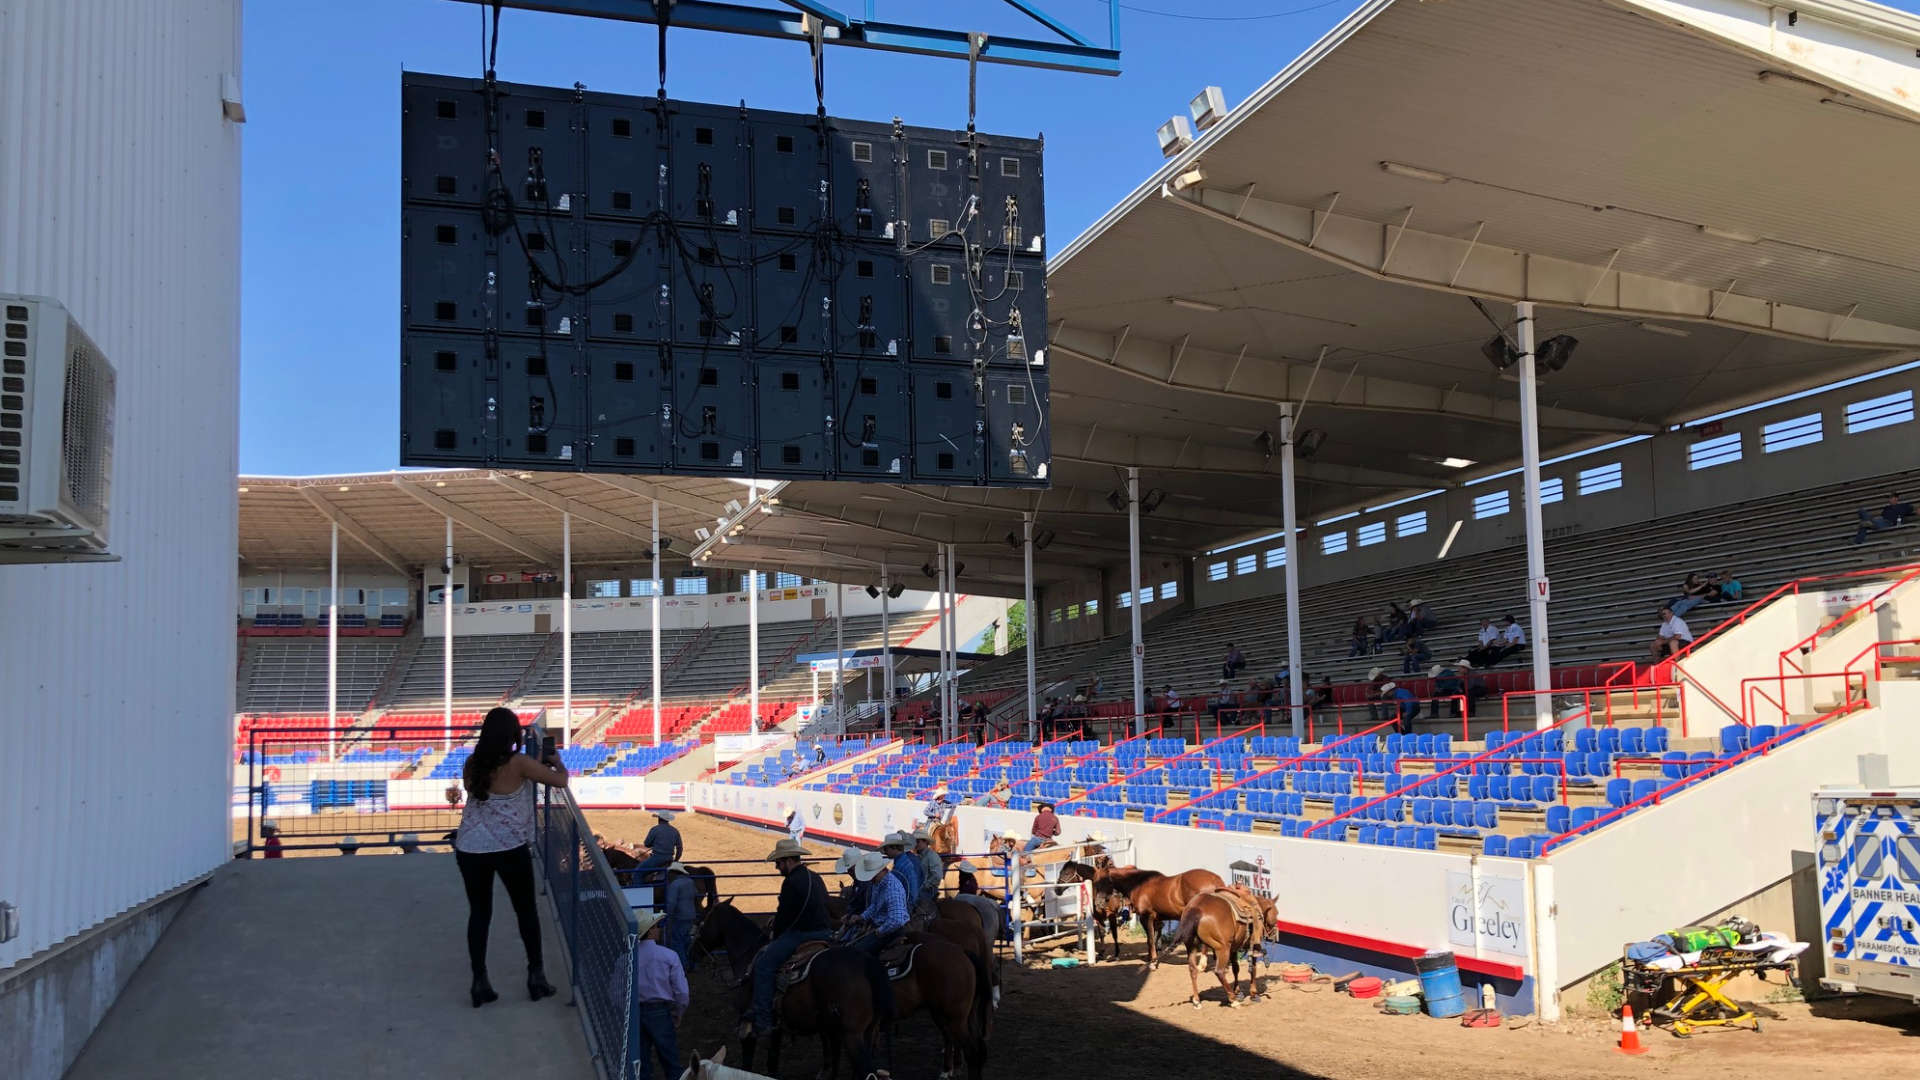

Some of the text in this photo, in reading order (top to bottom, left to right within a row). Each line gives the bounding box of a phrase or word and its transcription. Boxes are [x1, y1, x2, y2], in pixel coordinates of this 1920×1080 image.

[1538, 582, 1547, 596] V
[1136, 646, 1142, 654] U
[1853, 889, 1893, 901] BANNER
[1857, 941, 1901, 953] PARAMEDIC
